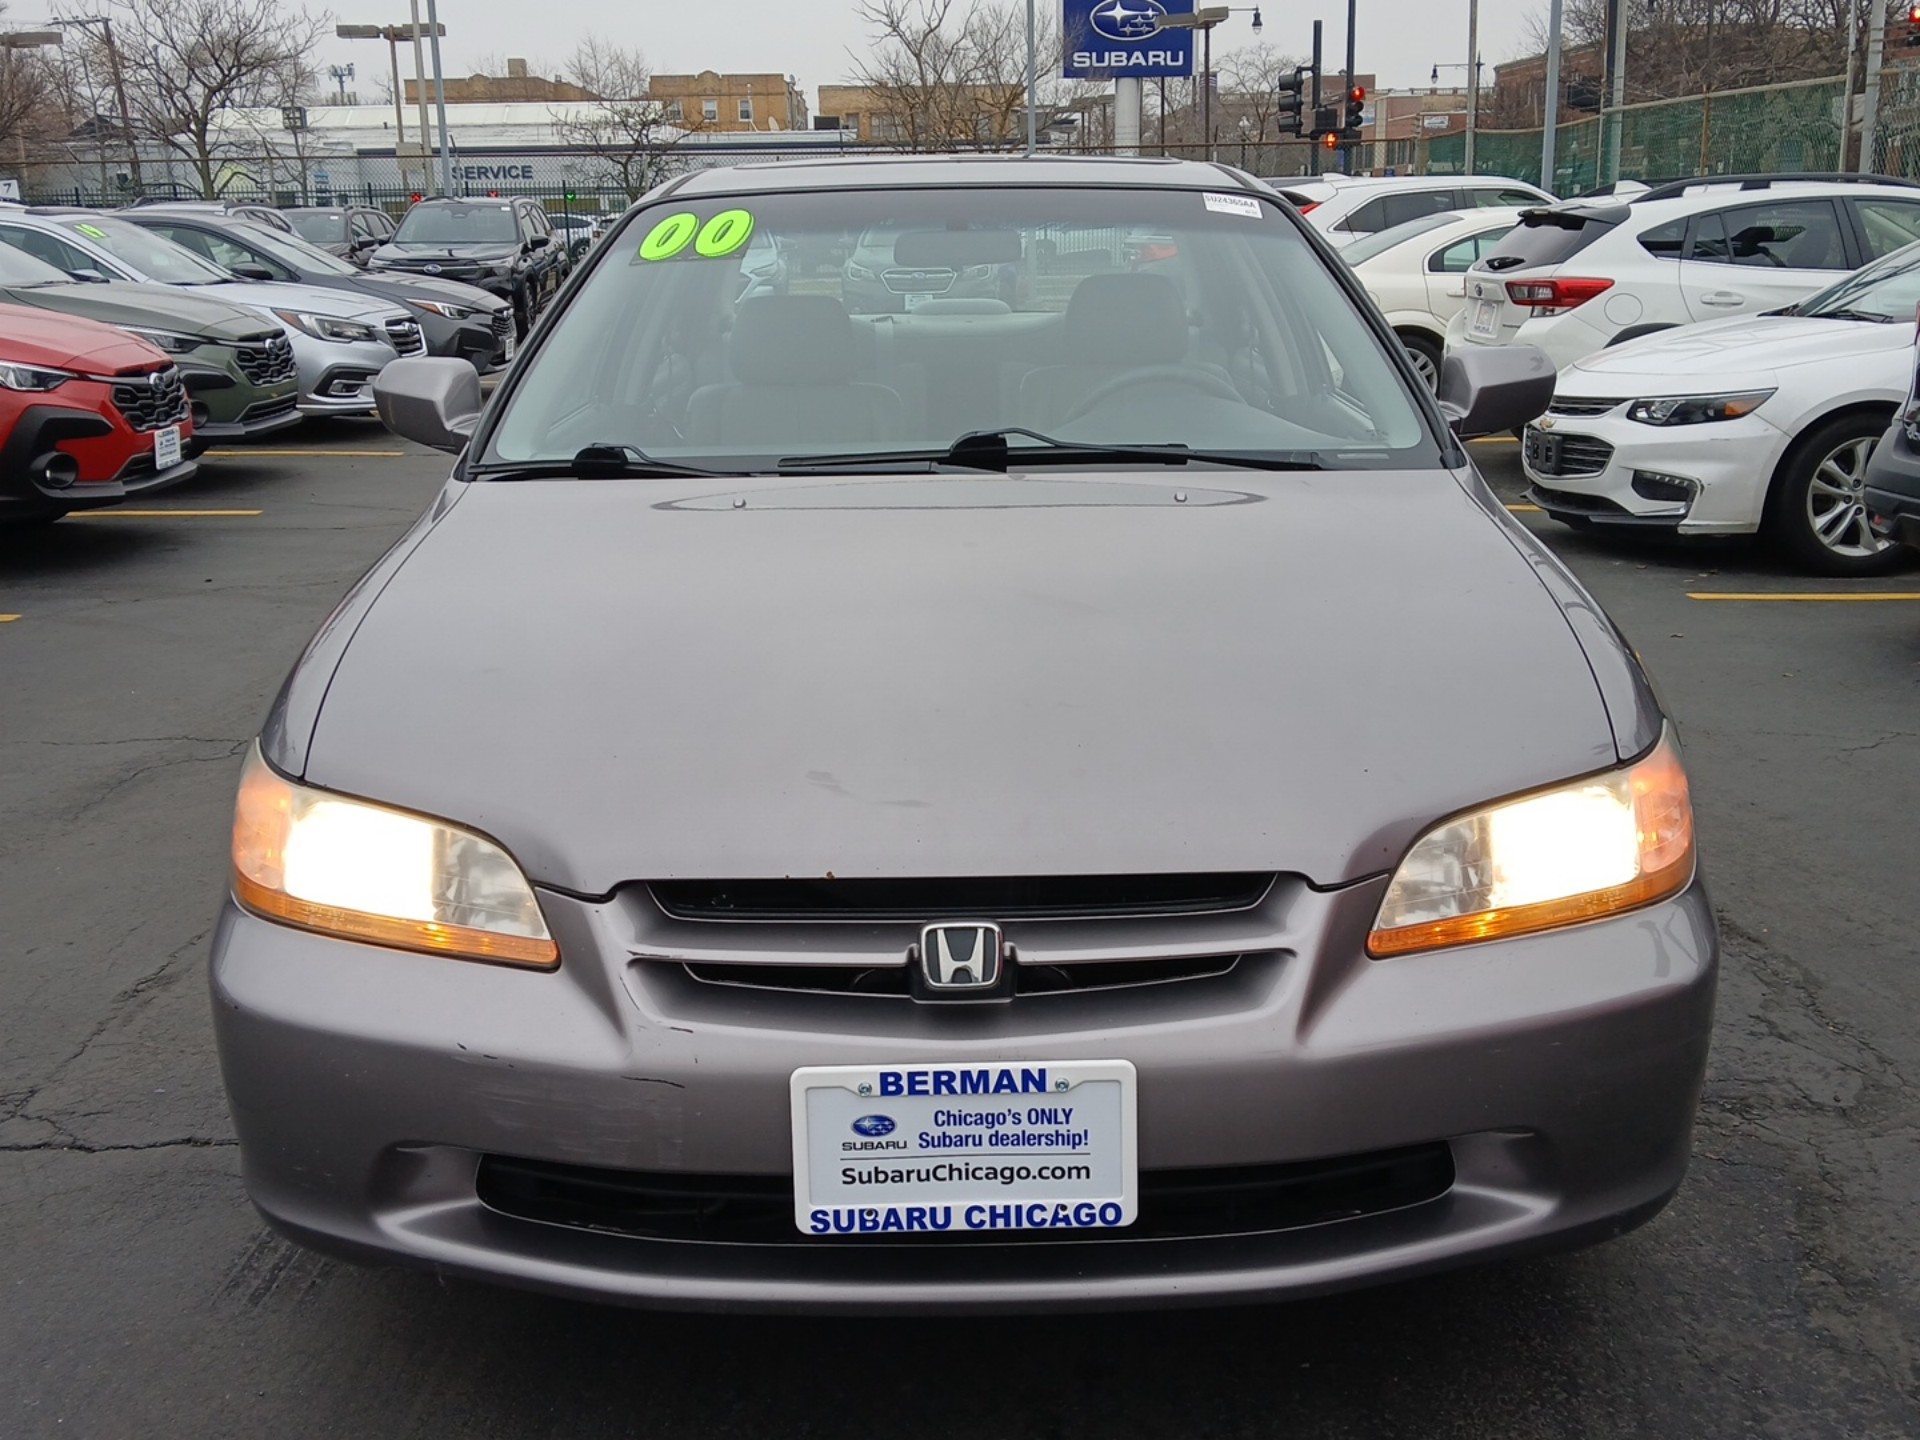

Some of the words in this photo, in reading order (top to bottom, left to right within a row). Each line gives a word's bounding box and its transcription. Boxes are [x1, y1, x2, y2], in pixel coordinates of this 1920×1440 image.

[1072, 50, 1184, 67] SUBARU
[451, 165, 534, 180] SERVICE
[639, 208, 755, 261] 00
[879, 1068, 1047, 1097] BERMAN
[934, 1109, 1022, 1129] Chicago's
[1027, 1107, 1073, 1125] ONLY
[841, 1141, 907, 1151] SUBARU
[918, 1131, 983, 1149] Subaru
[988, 1129, 1088, 1150] dealership!
[841, 1162, 1091, 1185] SubaruChicago.com
[809, 1207, 952, 1233] SUBARU
[963, 1202, 1123, 1230] CHICAGO
